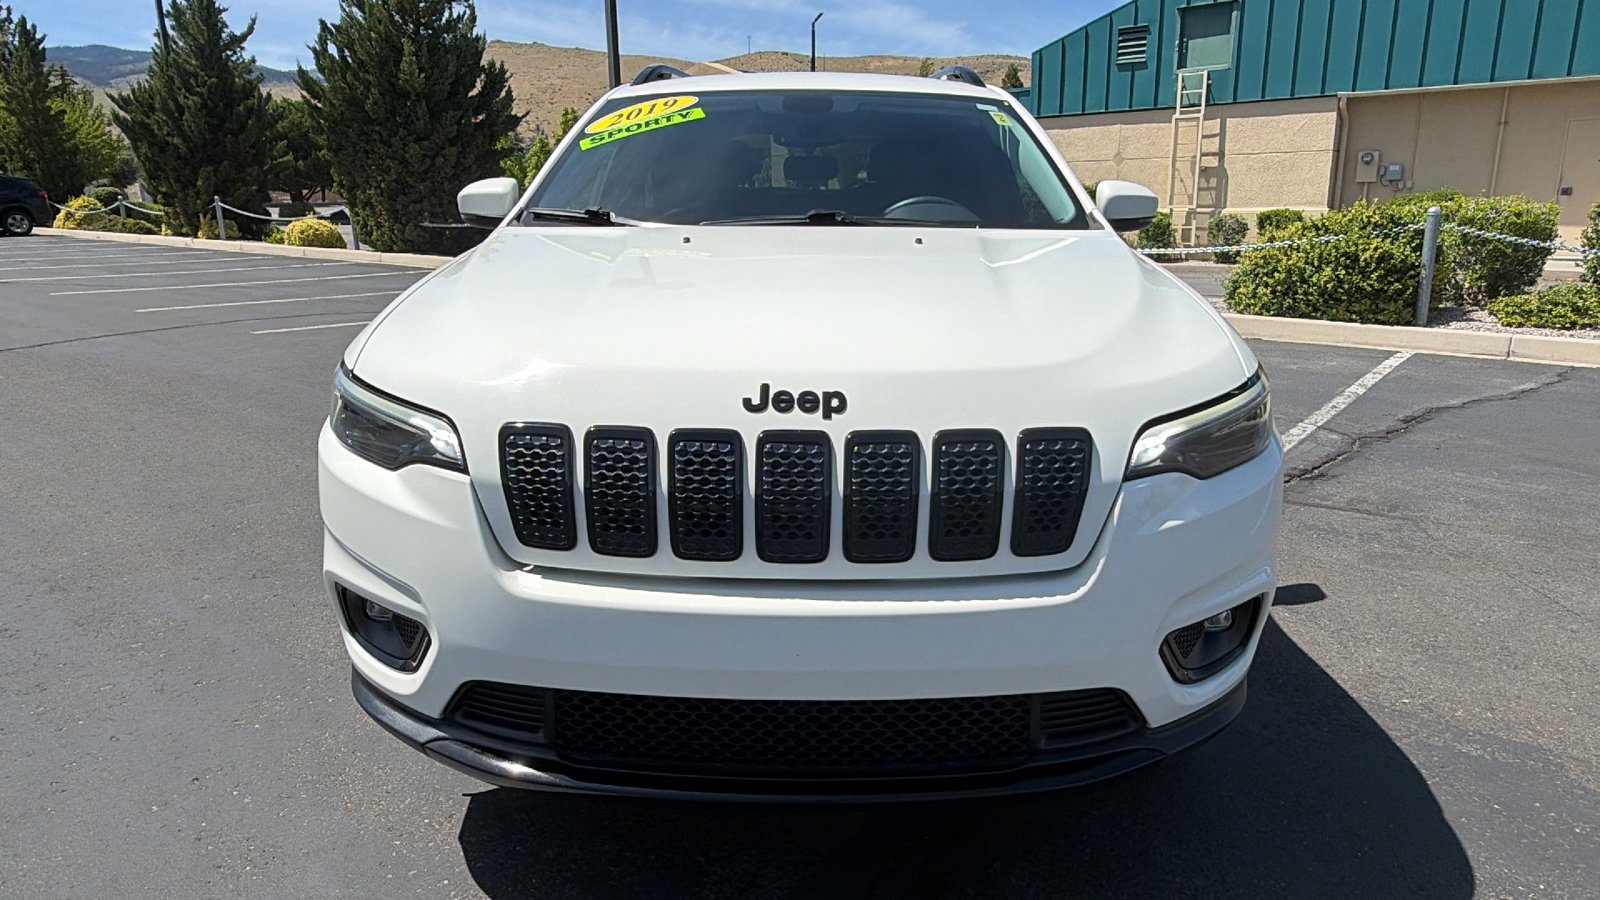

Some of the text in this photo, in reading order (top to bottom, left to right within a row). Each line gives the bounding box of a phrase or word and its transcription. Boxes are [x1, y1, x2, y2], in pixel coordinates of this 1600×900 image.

[588, 110, 696, 146] SPORTY
[607, 98, 679, 128] 2019
[742, 383, 848, 420] Jeep
